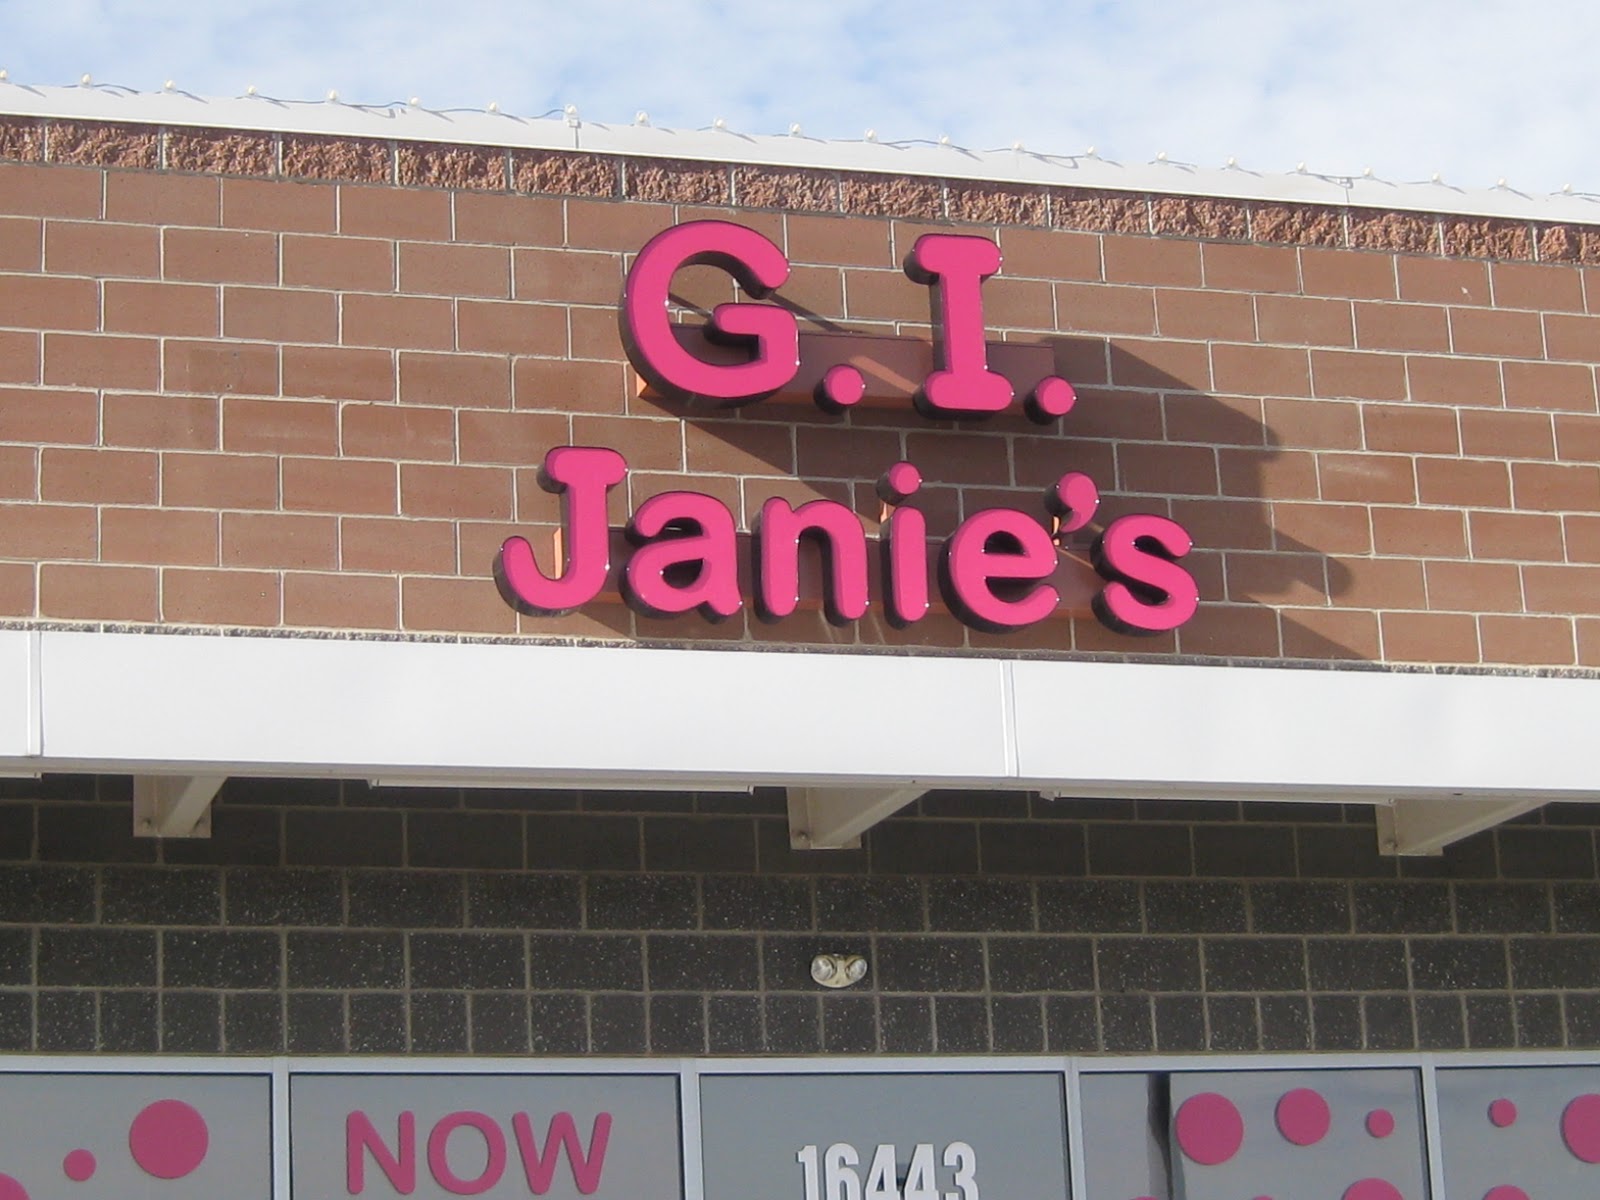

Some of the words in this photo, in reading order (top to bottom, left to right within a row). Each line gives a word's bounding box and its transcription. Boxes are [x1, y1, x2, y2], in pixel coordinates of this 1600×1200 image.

[622, 219, 1078, 417] G.I.
[498, 445, 1201, 633] Janie's
[346, 1111, 612, 1195] NOW
[797, 1141, 979, 1200] 16443
